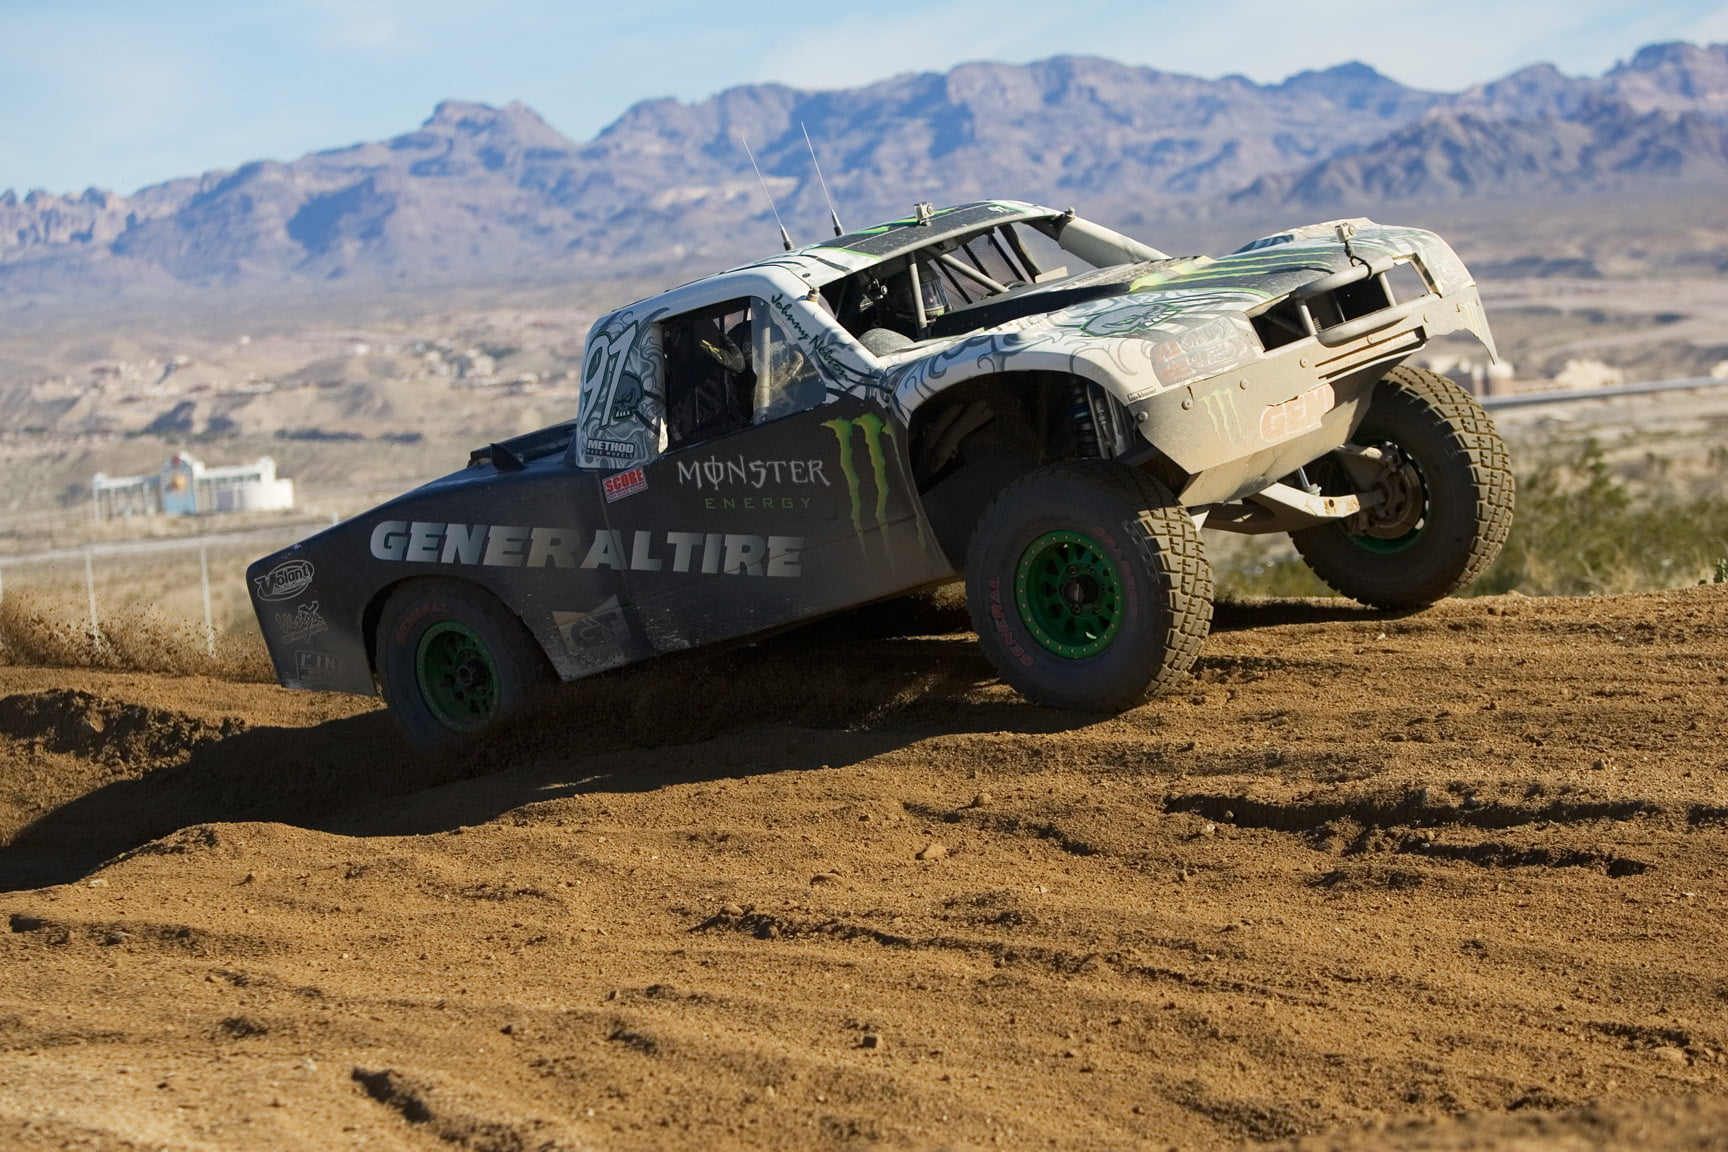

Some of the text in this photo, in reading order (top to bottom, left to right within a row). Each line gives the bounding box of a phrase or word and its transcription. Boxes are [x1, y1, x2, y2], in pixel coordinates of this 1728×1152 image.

[771, 293, 851, 382] Johnny Nelson
[581, 320, 638, 429] 91
[587, 439, 634, 454] METHOD
[605, 468, 644, 493] SCORE
[704, 497, 811, 510] ENERGY
[370, 520, 804, 577] GENERAL TIRE
